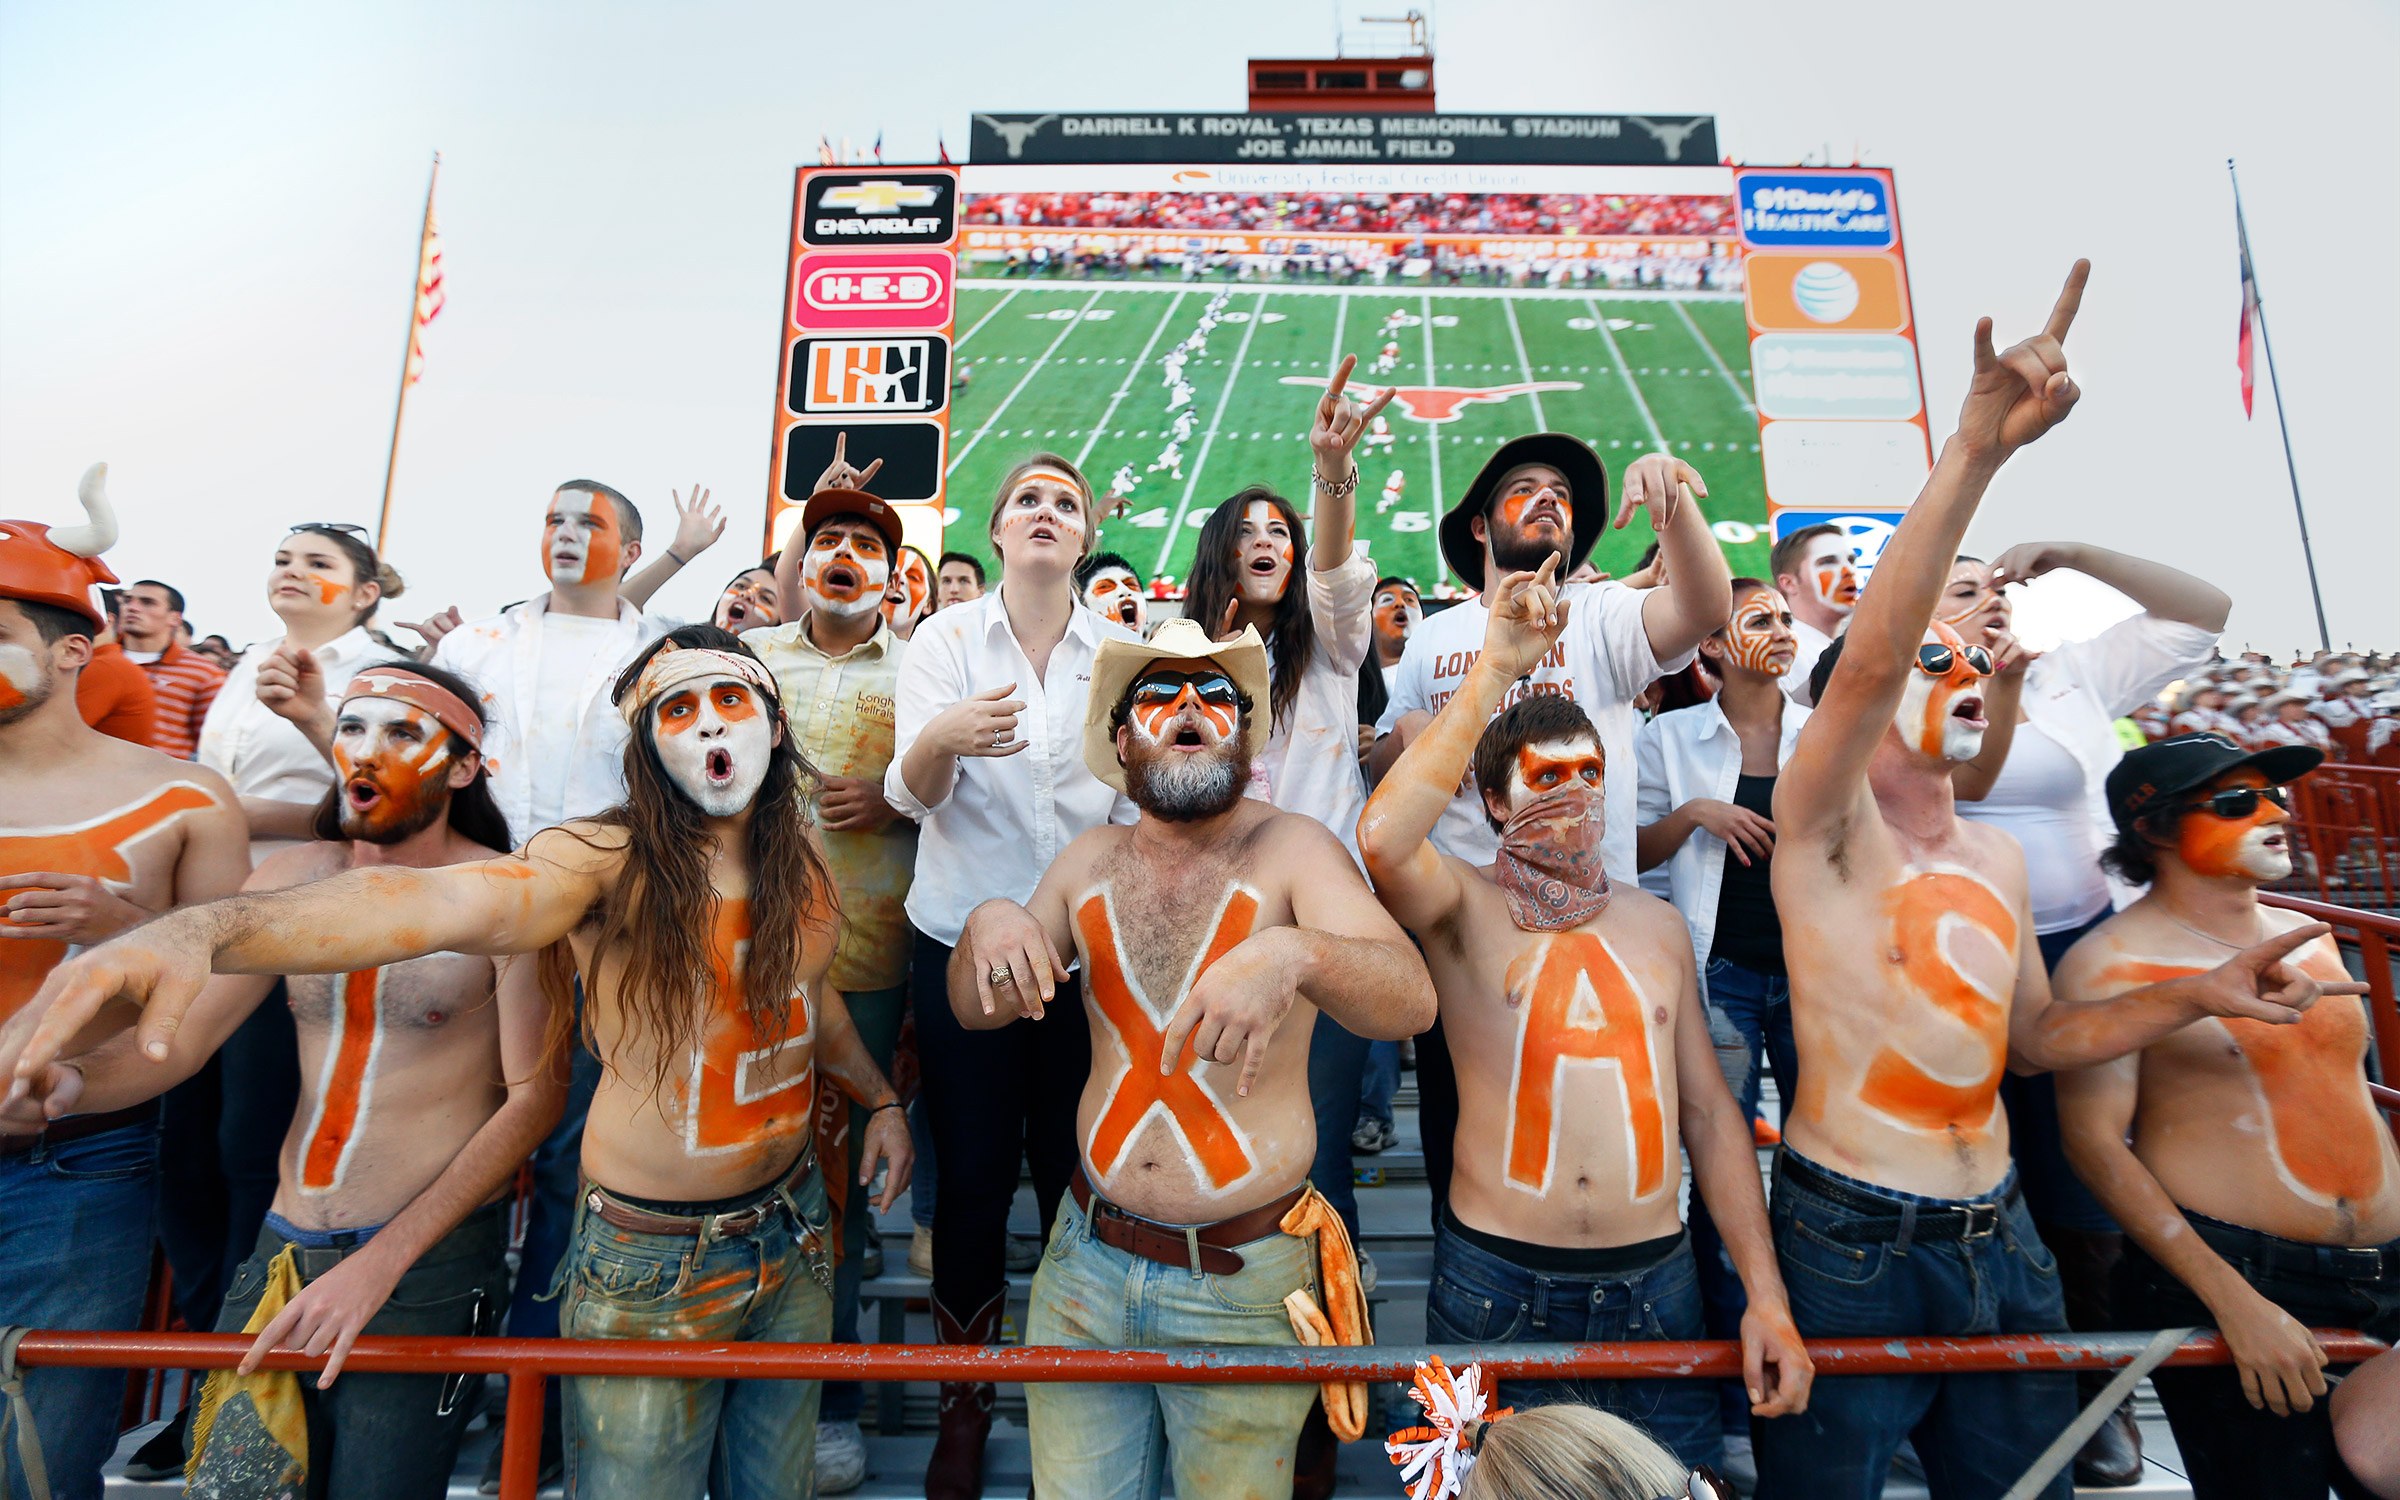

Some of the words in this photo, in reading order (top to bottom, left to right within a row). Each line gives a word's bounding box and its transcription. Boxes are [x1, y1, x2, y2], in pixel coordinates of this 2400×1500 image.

[1062, 118, 1171, 136] DARRELL
[1177, 118, 1197, 136] K
[1202, 118, 1280, 136] ROYAL
[1296, 118, 1374, 136] TEXAS
[1380, 118, 1507, 137] MEMORIAL
[1512, 118, 1621, 137] STADIUM
[1218, 168, 1311, 190] University
[1322, 167, 1393, 185] Federal
[1401, 168, 1459, 186] Credit
[1467, 170, 1526, 186] Union
[1237, 139, 1286, 157] JOE
[1292, 139, 1380, 157] JAMAIL
[1386, 139, 1455, 157] FIELD
[815, 217, 942, 235] CHEVROLET
[682, 897, 814, 1158] E
[1076, 880, 1263, 1198] X
[1503, 932, 1667, 1202] A
[1860, 862, 2018, 1136] S
